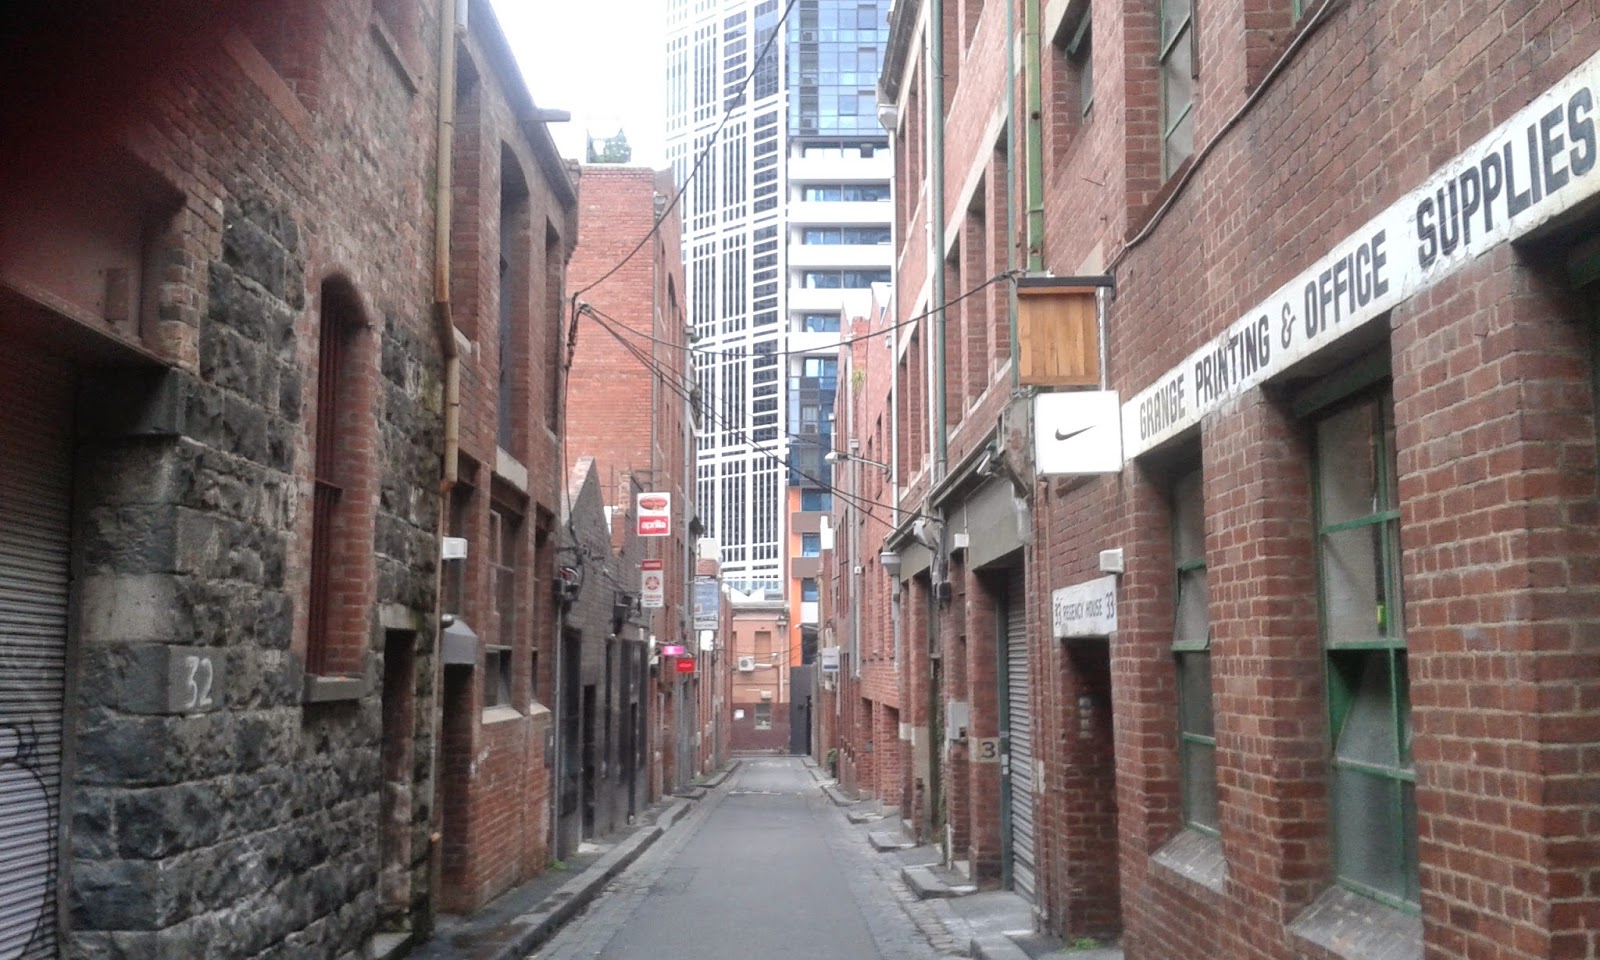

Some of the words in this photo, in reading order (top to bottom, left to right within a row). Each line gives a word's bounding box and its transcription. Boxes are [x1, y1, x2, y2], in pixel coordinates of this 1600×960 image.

[1140, 373, 1186, 441] GRANGE
[1195, 314, 1271, 409] PRINTING
[1280, 301, 1296, 350] &
[1304, 229, 1390, 340] OFFICE
[1416, 86, 1597, 270] SUPPLIES
[1062, 602, 1084, 621] REGENCY
[1085, 598, 1103, 618] HOUSE
[1105, 591, 1115, 620] 33
[185, 655, 213, 708] 32
[980, 741, 996, 759] 3
